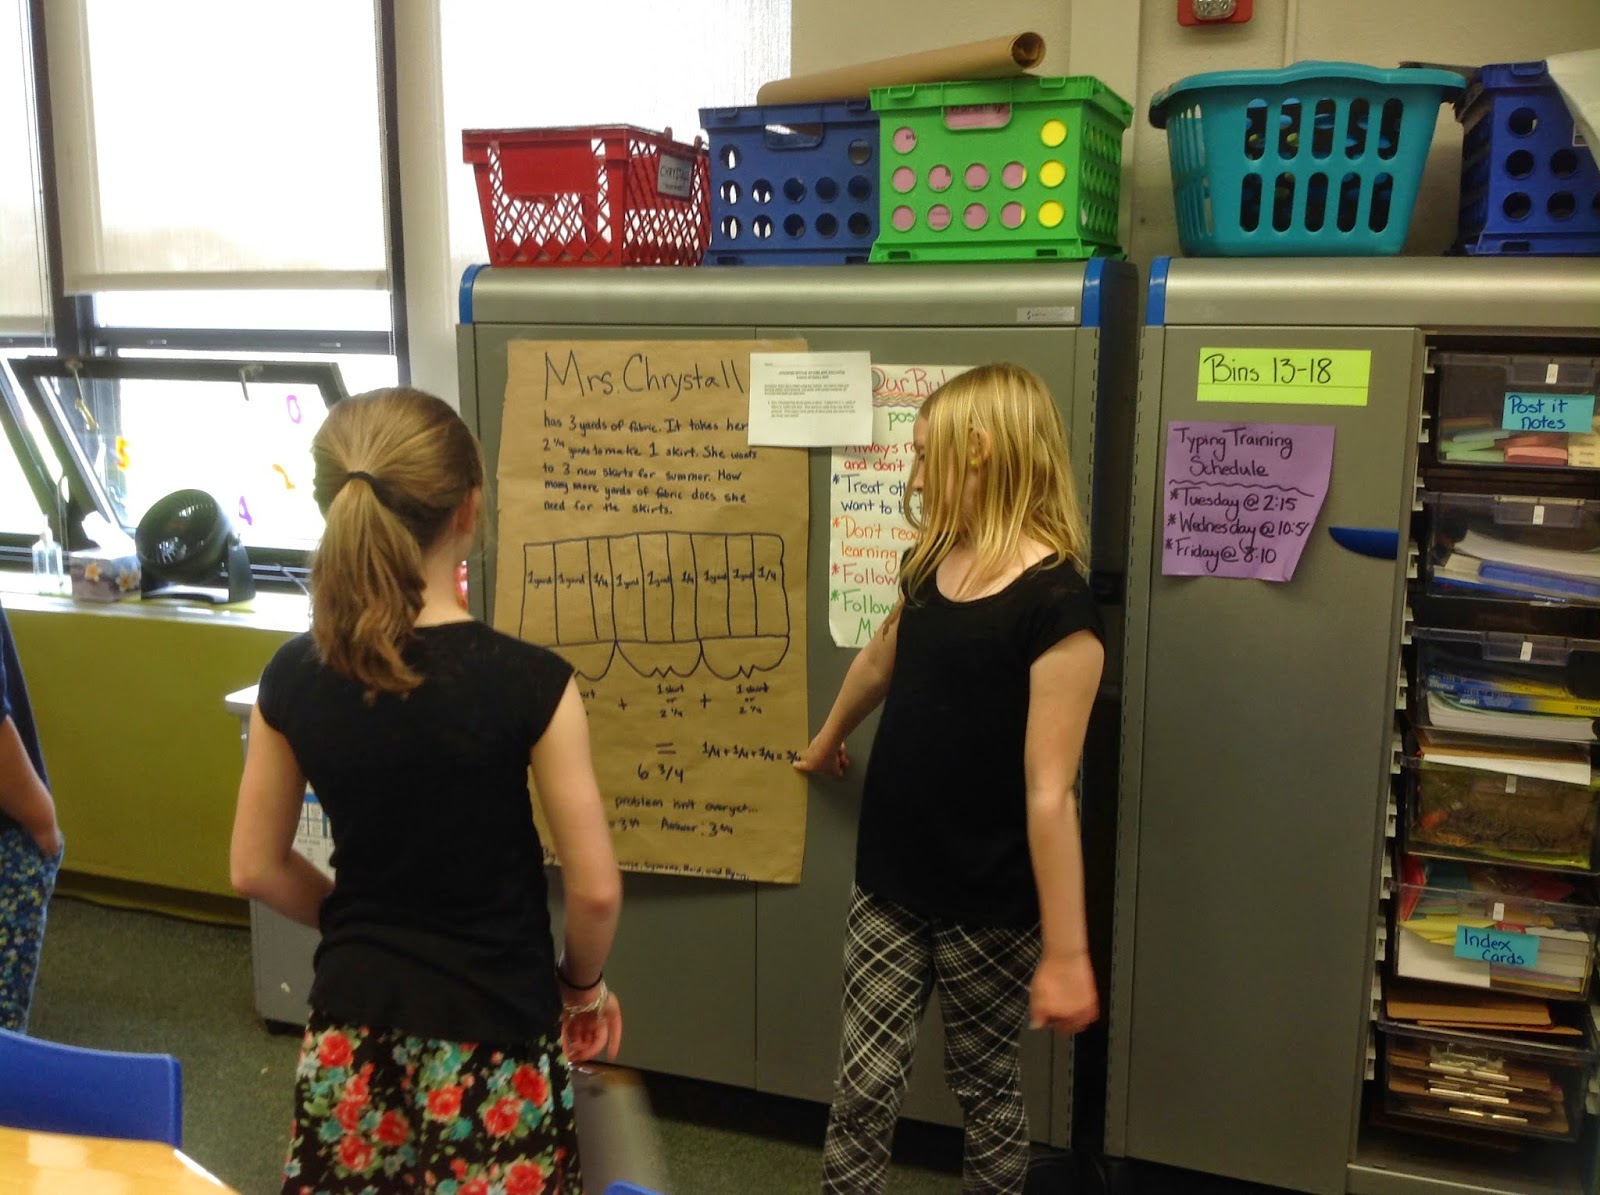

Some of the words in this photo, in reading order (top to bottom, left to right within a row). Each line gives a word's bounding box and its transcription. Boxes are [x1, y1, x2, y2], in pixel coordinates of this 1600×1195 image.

[544, 350, 620, 400] Mrs.
[623, 353, 745, 402] Chrystall
[1203, 353, 1260, 383] Bins
[1273, 357, 1333, 384] 13-18
[1508, 394, 1545, 415] Post
[1552, 399, 1568, 413] it
[543, 409, 563, 428] has
[568, 414, 577, 431] 3
[579, 417, 608, 438] yards
[610, 418, 625, 432] of
[664, 418, 682, 433] It
[689, 418, 719, 431] takes
[726, 417, 749, 431] her
[1521, 416, 1566, 430] notes
[702, 445, 726, 459] She
[1173, 427, 1226, 462] Typing
[1222, 427, 1293, 460] Training
[717, 469, 743, 481] How
[844, 458, 868, 471] and
[873, 458, 905, 472] don't
[1189, 455, 1269, 477] Schedule
[841, 473, 885, 495] Treat
[841, 499, 874, 512] want
[879, 499, 893, 515] to
[1174, 487, 1240, 521] Tuesday
[1263, 494, 1298, 511] 2:15
[841, 516, 883, 539] Don't
[1179, 511, 1257, 550] Wednesday
[841, 541, 898, 574] learning
[1175, 537, 1220, 573] Friday
[843, 562, 899, 585] Follow
[843, 588, 895, 613] Follow
[1464, 928, 1513, 952] Index
